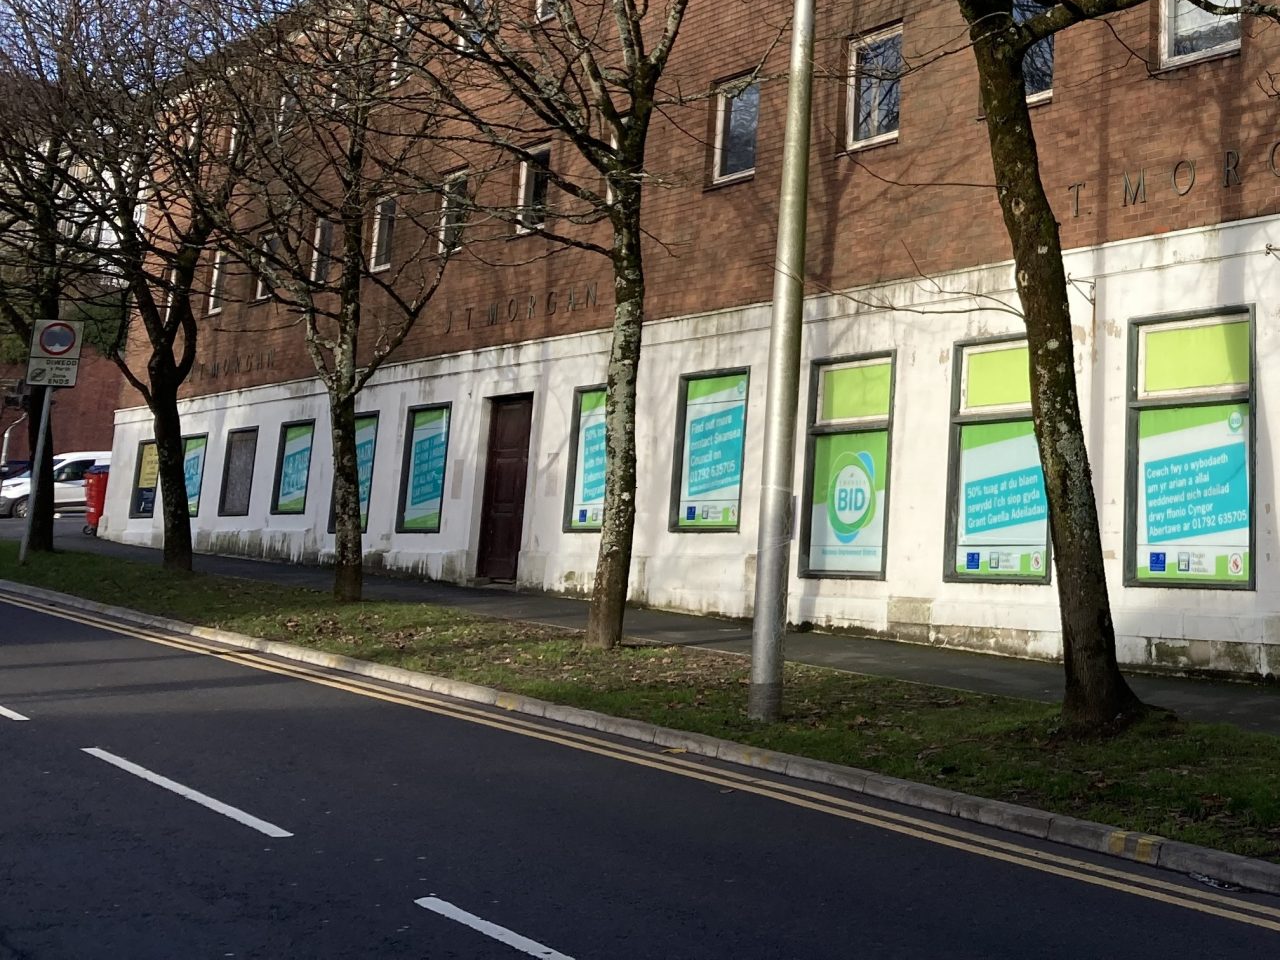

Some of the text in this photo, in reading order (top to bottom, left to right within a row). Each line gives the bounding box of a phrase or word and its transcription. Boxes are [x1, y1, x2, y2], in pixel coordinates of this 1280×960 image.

[691, 422, 704, 434] Find
[705, 419, 716, 430] out
[690, 450, 713, 465] Council
[1146, 466, 1169, 479] Cewch
[1170, 464, 1182, 475] fwy
[967, 485, 982, 499] 50%
[1147, 484, 1158, 493] am
[1160, 482, 1167, 493] yr
[1188, 477, 1193, 485] a
[837, 488, 865, 511] BID
[1149, 511, 1165, 522] drwy
[1187, 503, 1214, 517] Cyngor
[967, 517, 986, 528] Grant
[1149, 524, 1181, 536] Abertawe
[1183, 522, 1190, 531] ar
[1192, 515, 1216, 529] 01792
